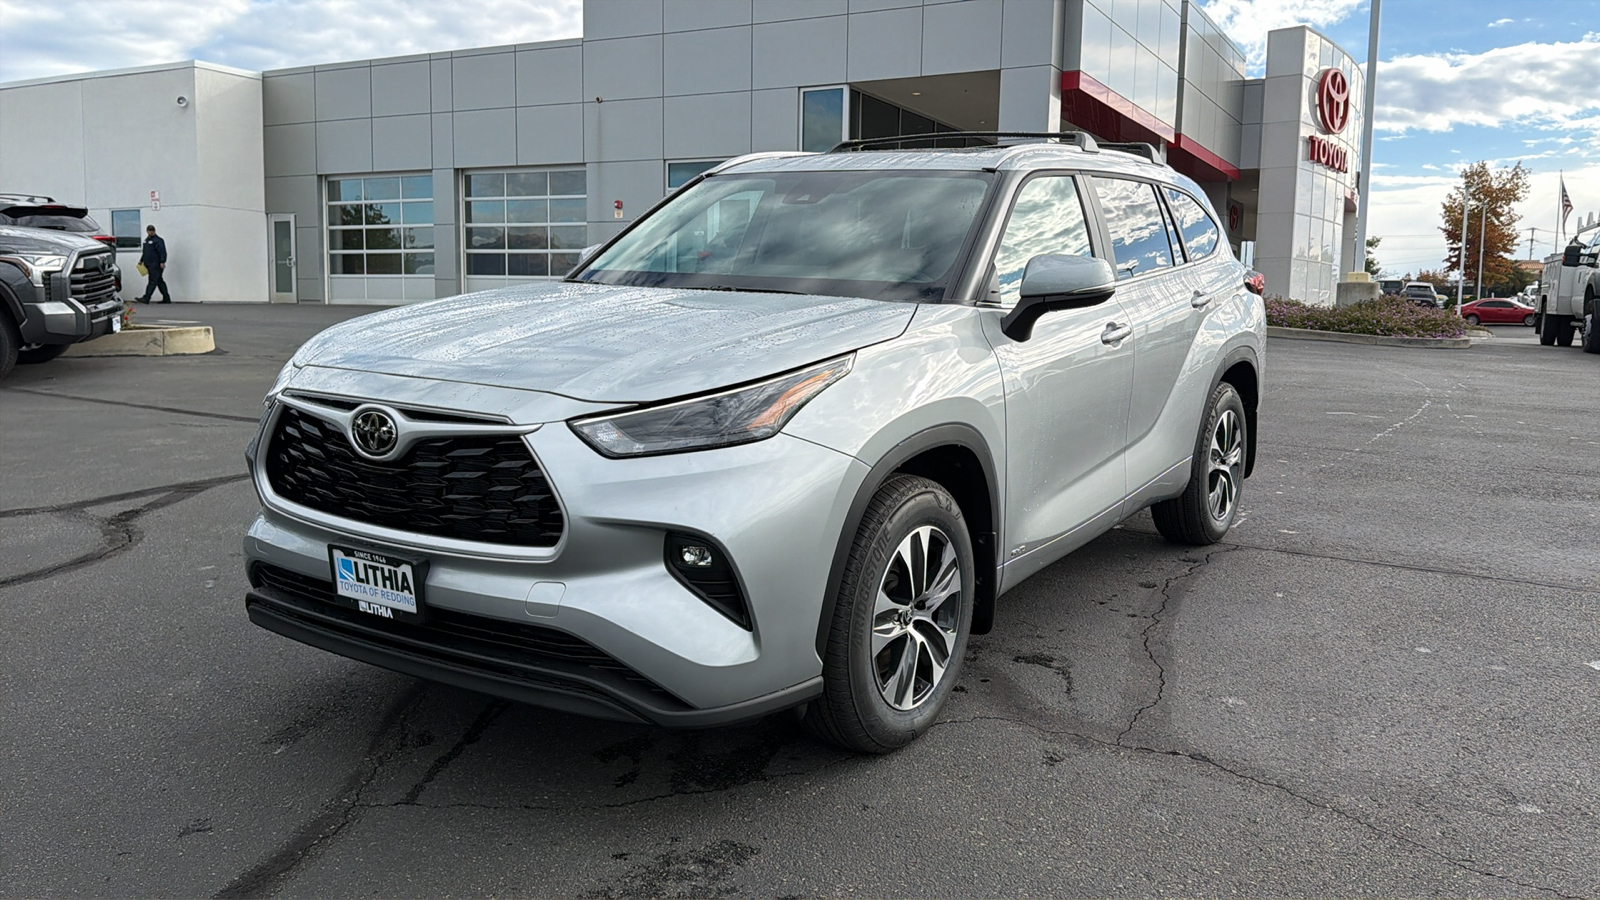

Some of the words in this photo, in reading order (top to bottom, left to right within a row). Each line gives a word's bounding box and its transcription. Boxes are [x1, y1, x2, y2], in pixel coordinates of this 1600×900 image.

[1309, 135, 1348, 173] TOYOTA
[354, 551, 372, 560] SINCE
[372, 555, 387, 564] 1946
[353, 561, 413, 595] LITHIA
[851, 526, 892, 650] BRIDGESTONE
[340, 581, 368, 596] TOYOTA
[369, 587, 379, 597] OF
[381, 590, 414, 606] REDDING
[366, 601, 393, 619] LITHIA
